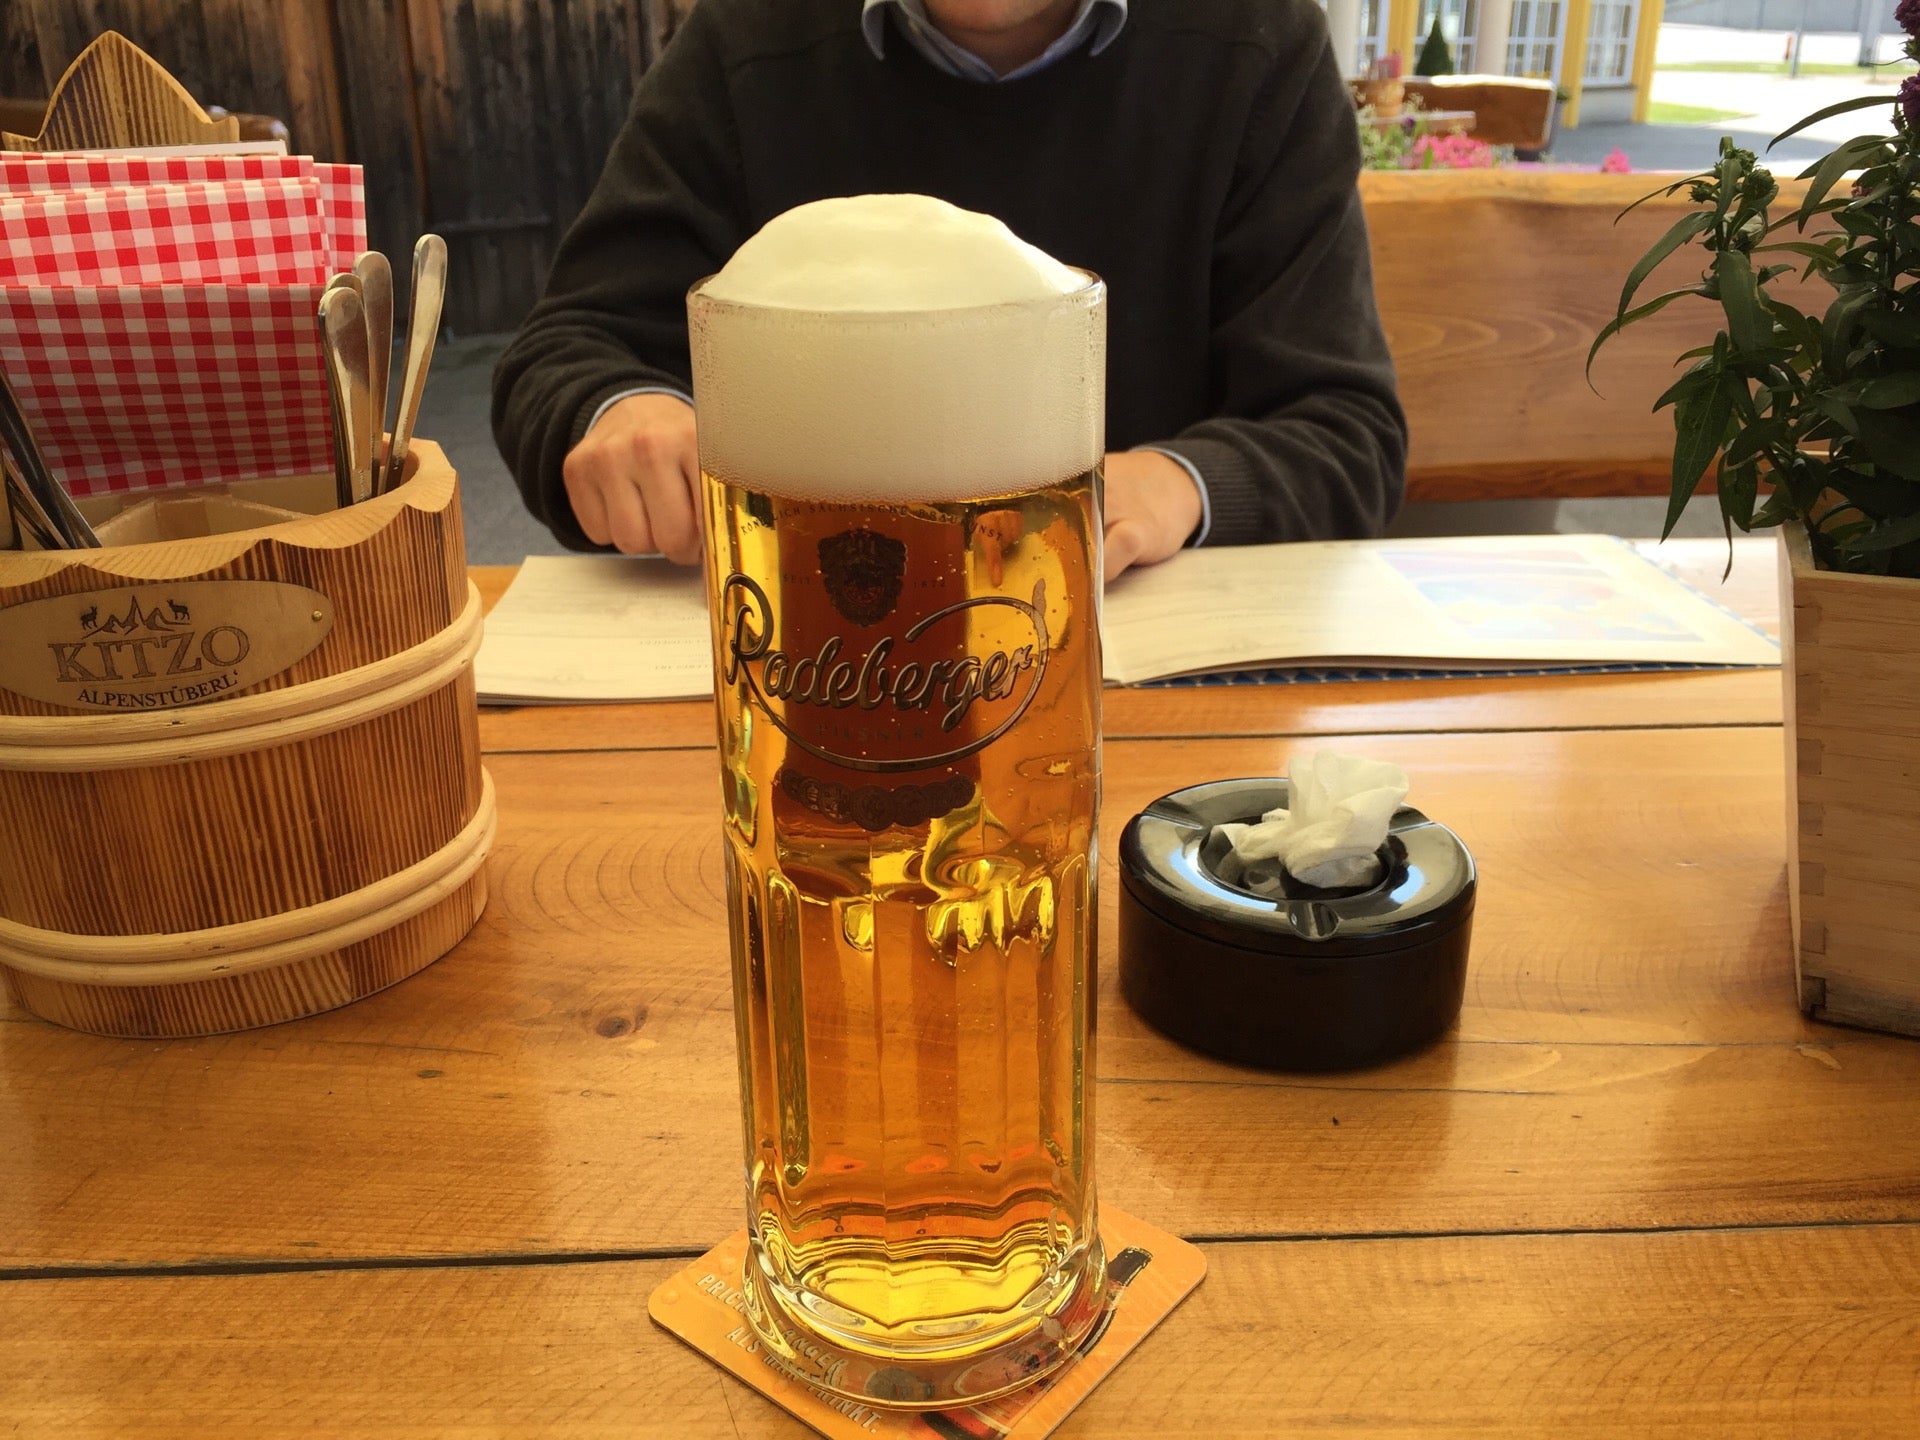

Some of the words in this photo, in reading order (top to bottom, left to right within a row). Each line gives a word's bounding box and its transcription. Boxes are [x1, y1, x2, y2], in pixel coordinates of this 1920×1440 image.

[918, 507, 1003, 542] BRAUUNST
[48, 625, 250, 683] KITZO
[722, 572, 1040, 735] Radeberger
[725, 1326, 761, 1354] ALS
